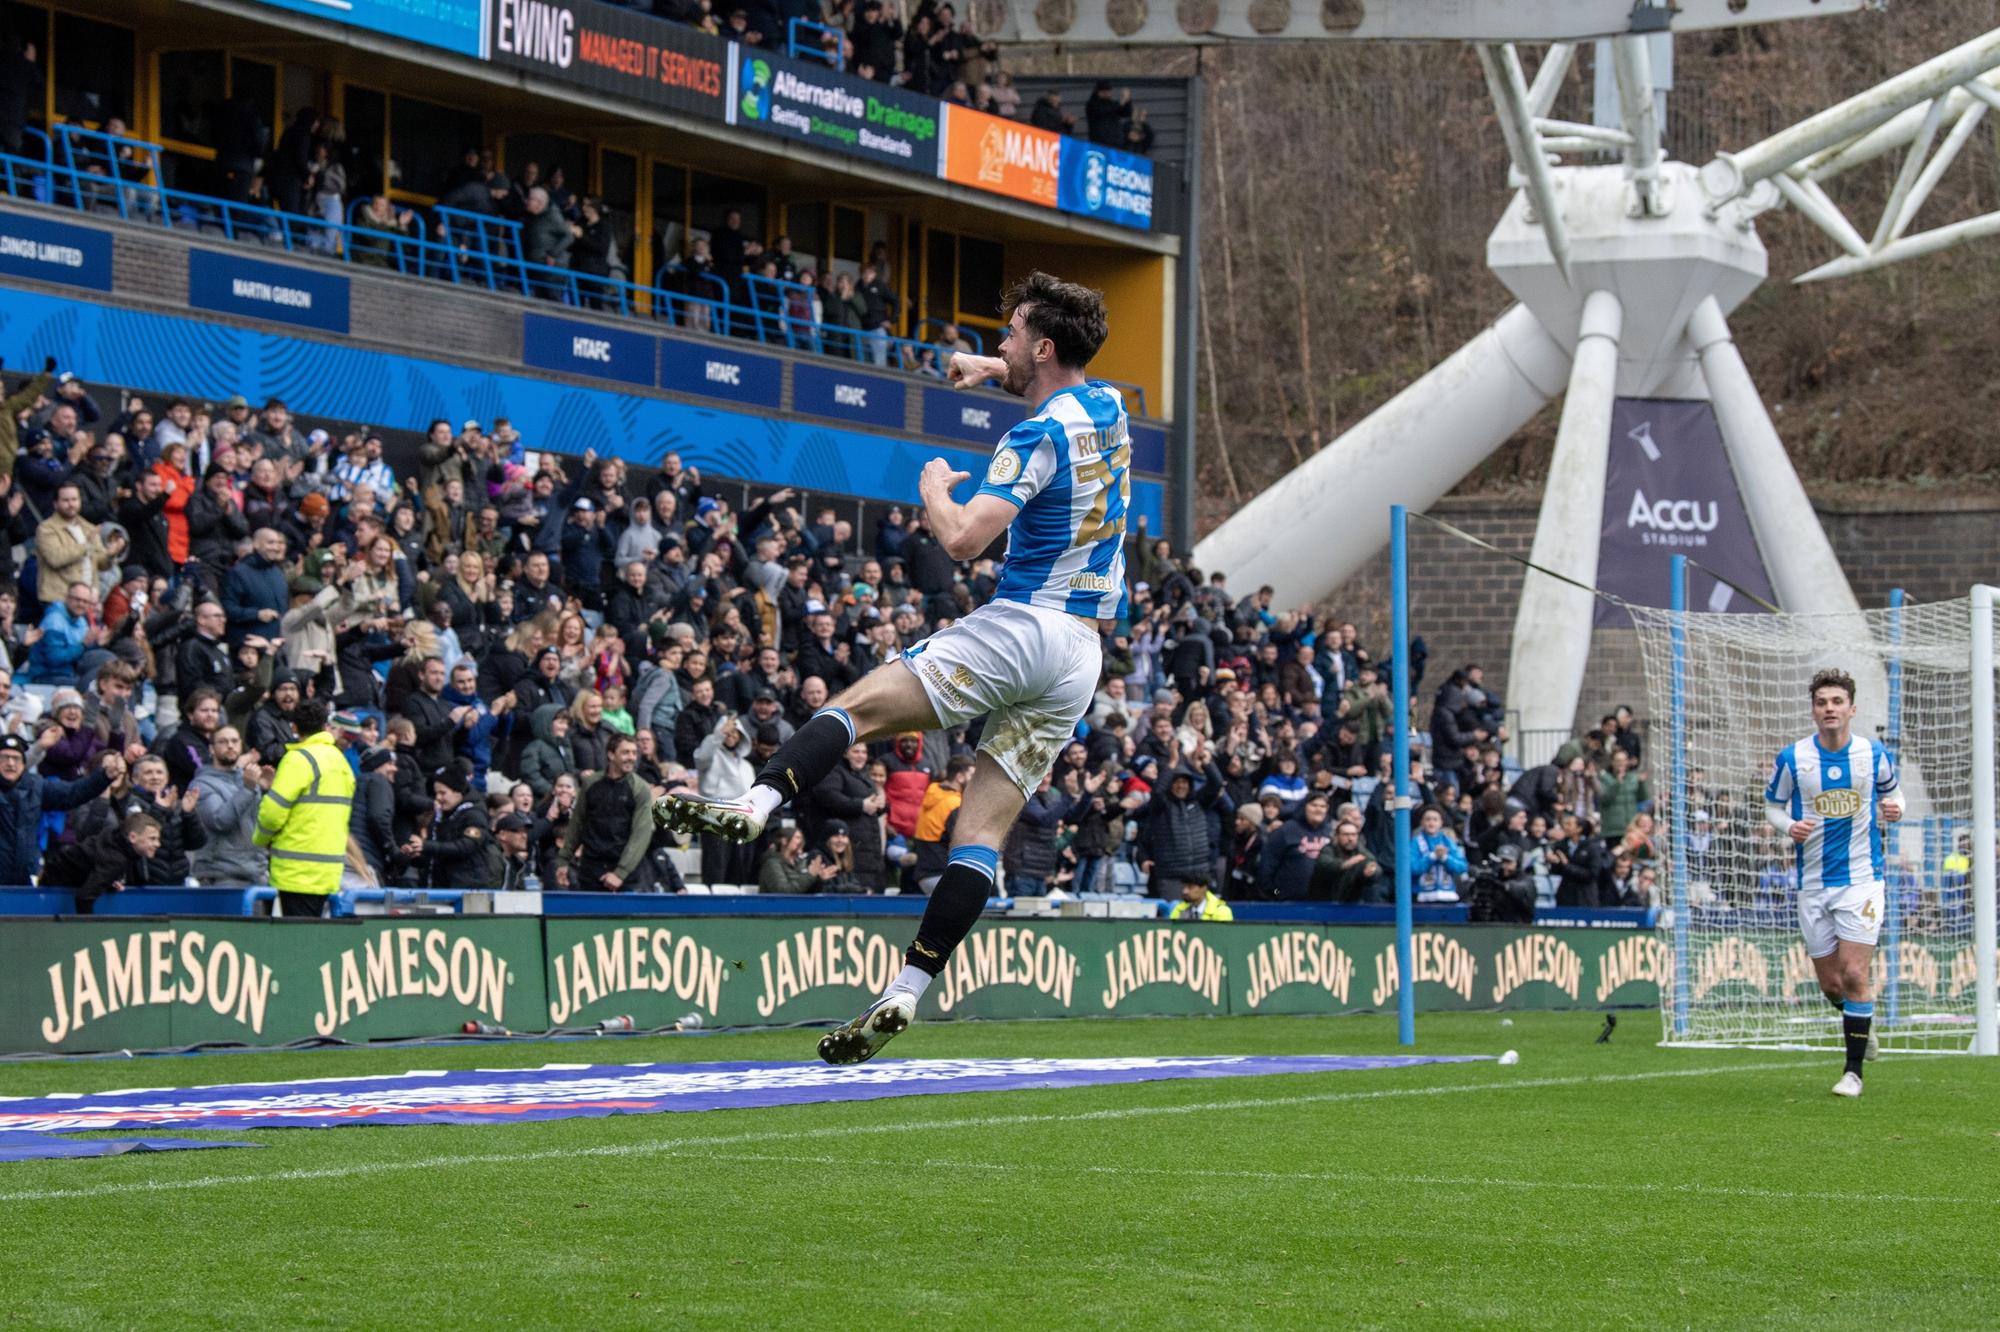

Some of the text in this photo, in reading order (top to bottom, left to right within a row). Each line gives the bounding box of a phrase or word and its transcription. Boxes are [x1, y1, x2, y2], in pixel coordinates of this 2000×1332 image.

[498, 0, 574, 69] EWING
[579, 28, 644, 77] MANAGED
[646, 46, 659, 79] IT
[660, 49, 721, 97] SERVICES
[771, 104, 912, 158] Setting Drainage Standards
[773, 70, 936, 141] Alternative Drainage
[1004, 129, 1060, 177] MANG
[38, 242, 83, 268] LIMITED
[233, 278, 272, 302] MARTIN
[573, 336, 611, 362] HTAFC
[1641, 531, 1708, 547] STADIUM
[924, 659, 967, 709] TOMLINSON
[1816, 794, 1858, 815] DUDE
[1861, 899, 1876, 922] 4
[41, 929, 273, 1043] JAMESON
[315, 928, 507, 1036] JAMESON
[551, 927, 724, 1024] JAMESON
[1103, 929, 1223, 1009] JAMESON
[1246, 931, 1352, 1008] JAMESON
[1493, 933, 1582, 1003] JAMESON
